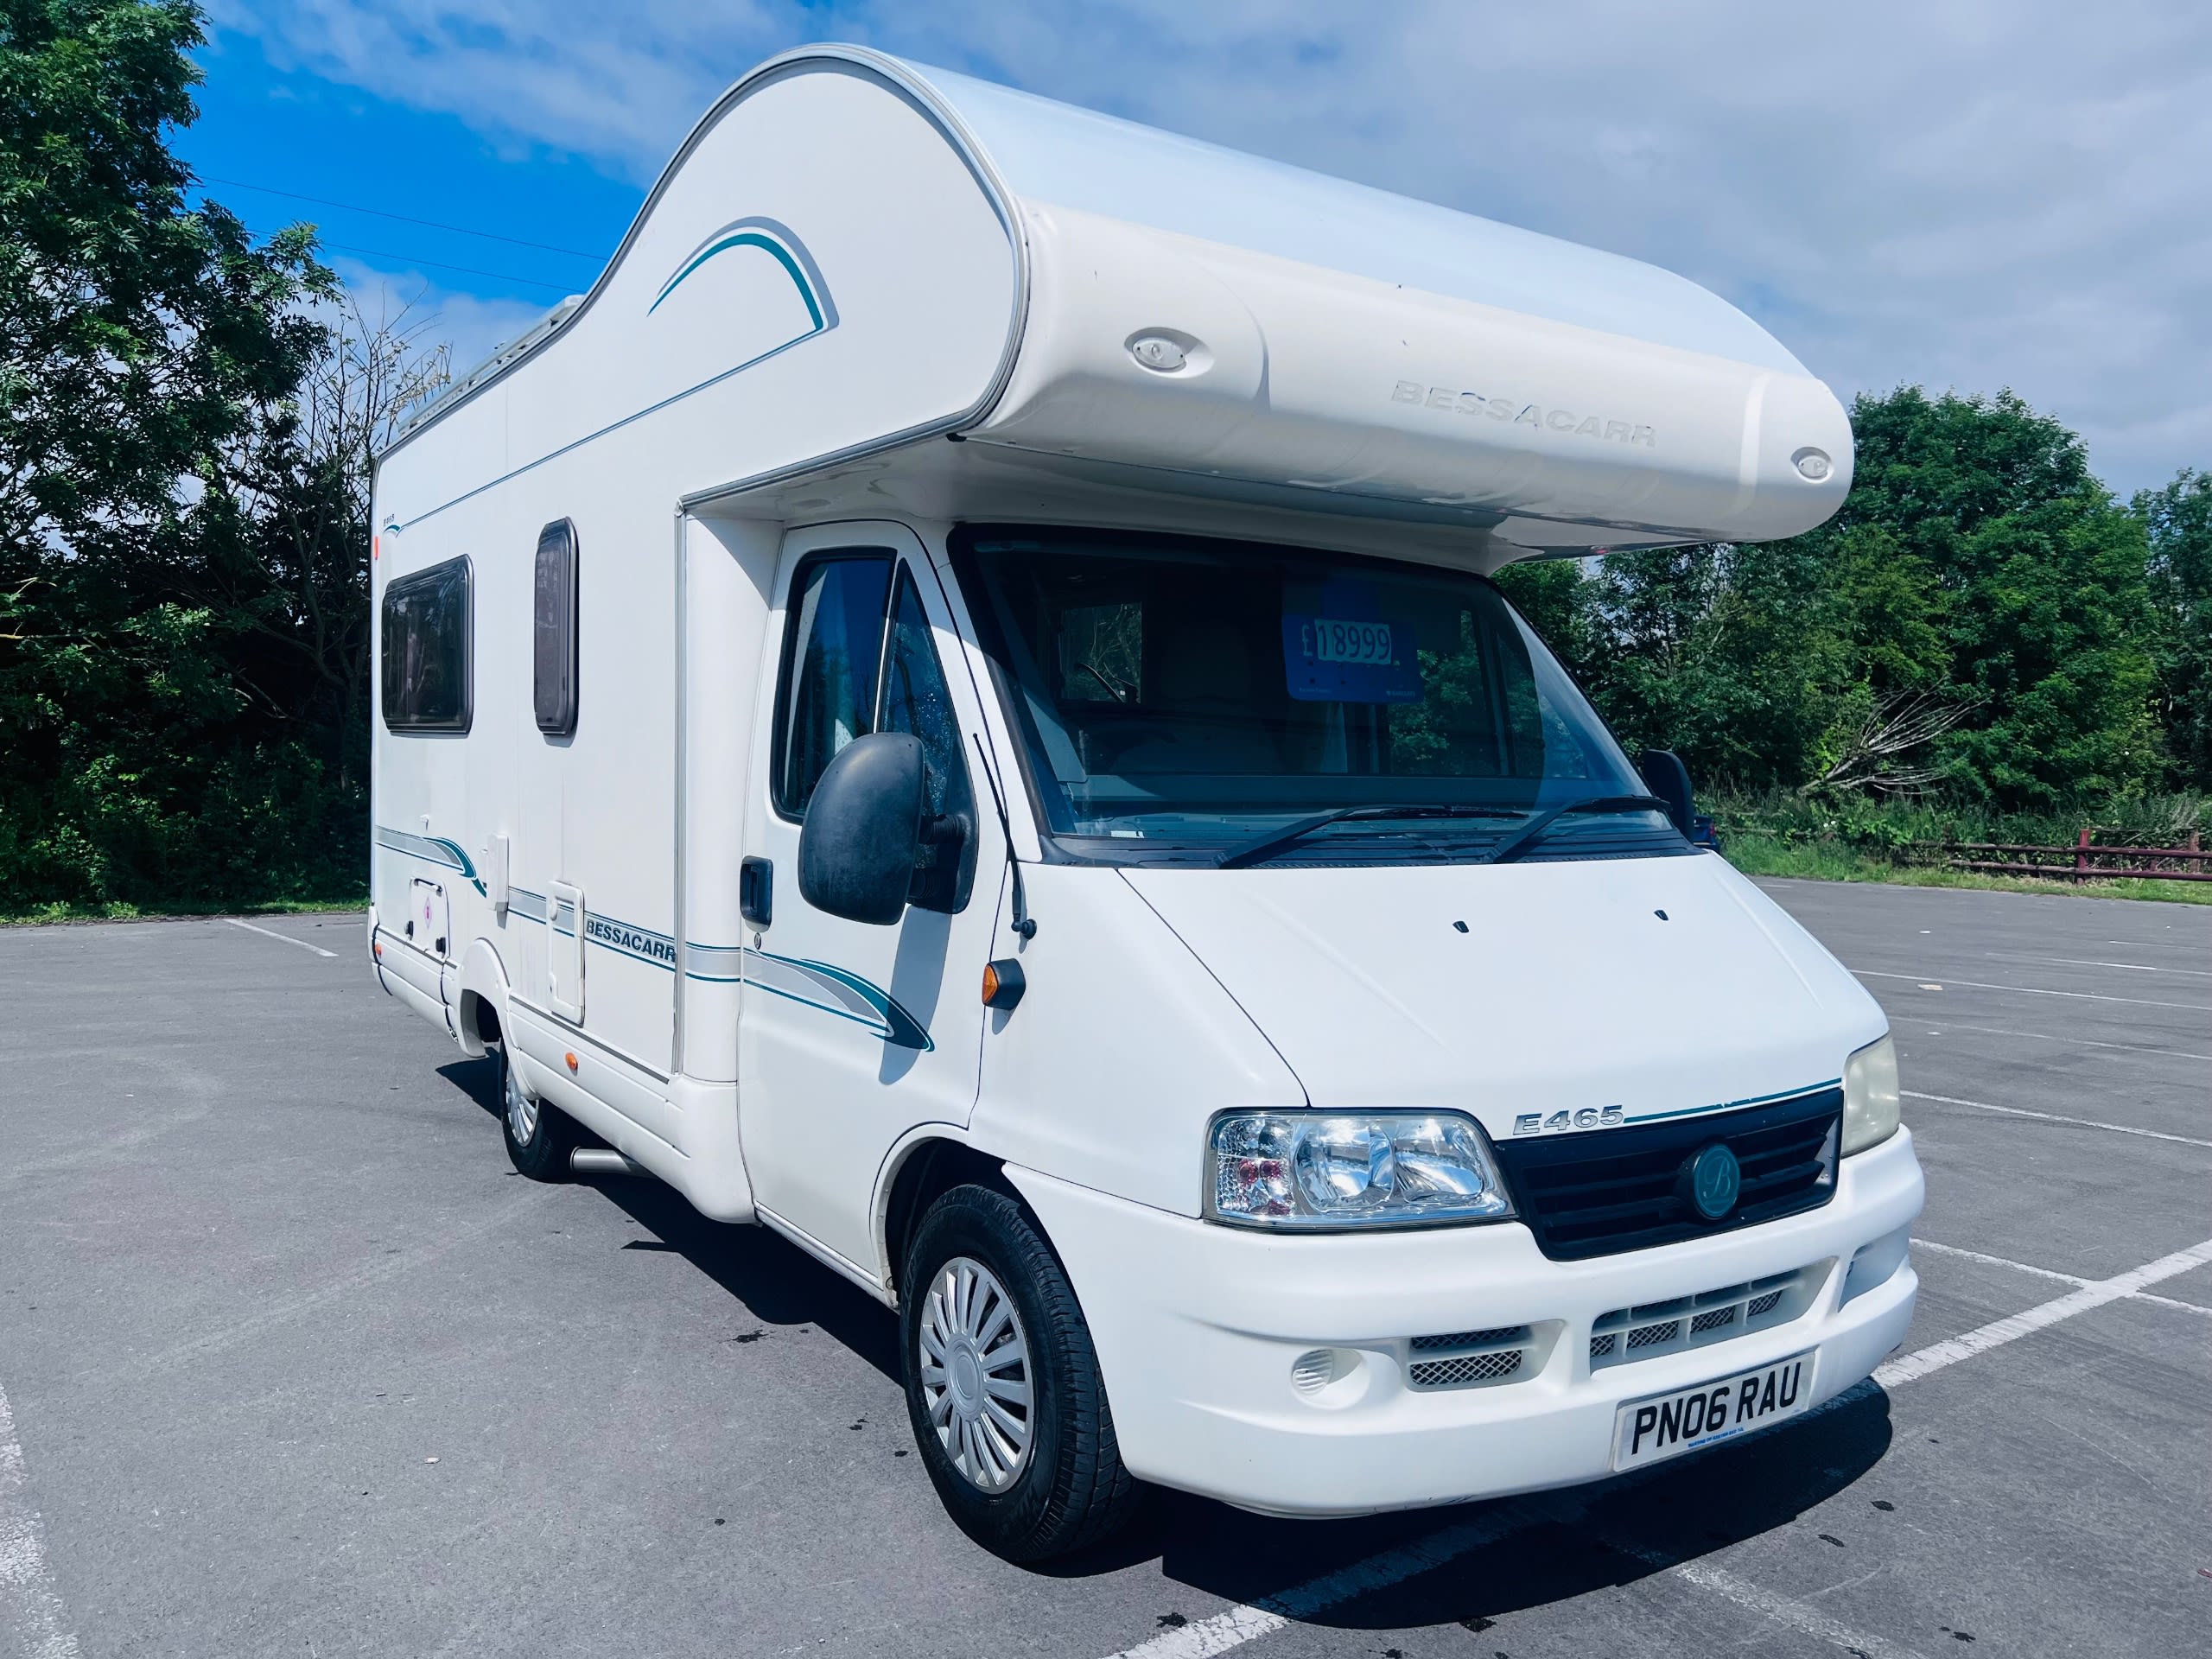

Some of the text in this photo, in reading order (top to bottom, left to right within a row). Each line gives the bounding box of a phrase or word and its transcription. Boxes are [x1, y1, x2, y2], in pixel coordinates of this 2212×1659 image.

[1391, 379, 1656, 448] BESSACARR
[586, 918, 677, 963] BESSACARR
[1512, 1104, 1624, 1136] E465
[1630, 1361, 1802, 1456] PN06 RAU
